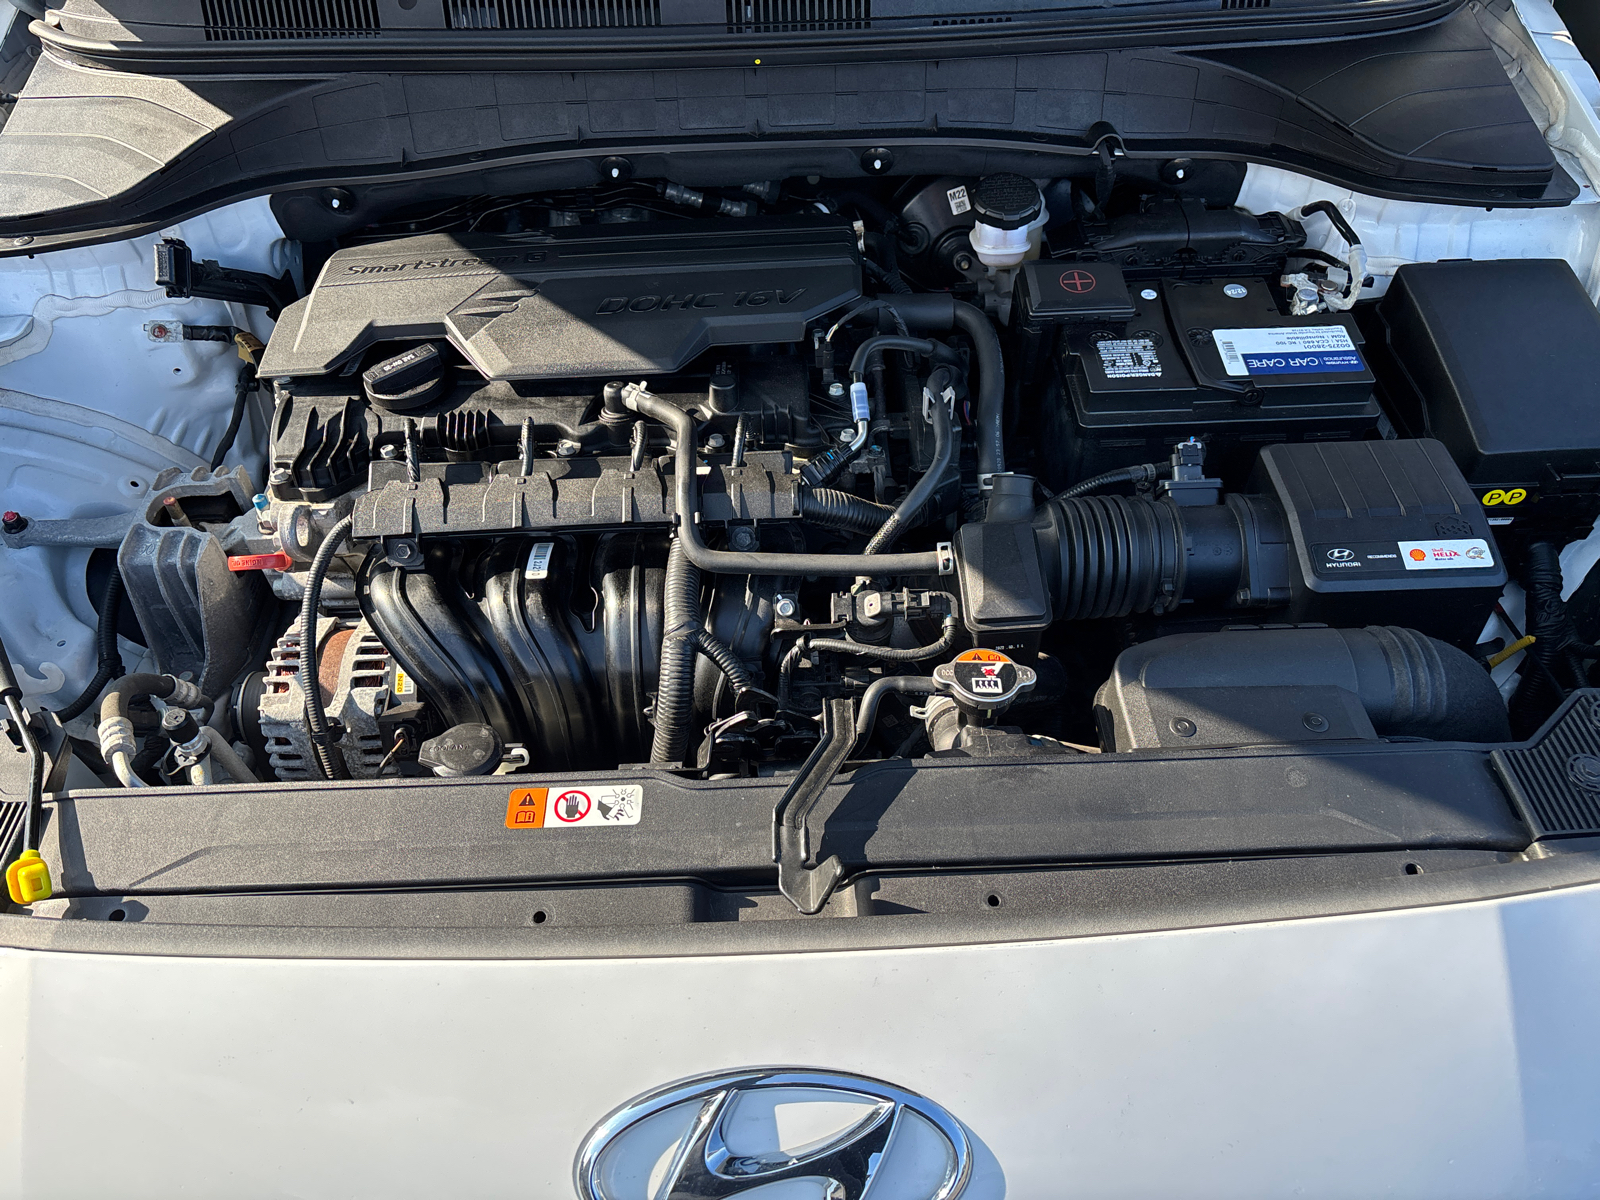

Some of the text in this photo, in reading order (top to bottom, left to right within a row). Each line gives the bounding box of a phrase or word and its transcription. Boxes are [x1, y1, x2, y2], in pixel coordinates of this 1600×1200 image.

[948, 188, 967, 202] M22
[342, 255, 519, 276] Smartstream
[595, 288, 808, 315] DOHC 16V
[1246, 357, 1319, 368] CAR CARE
